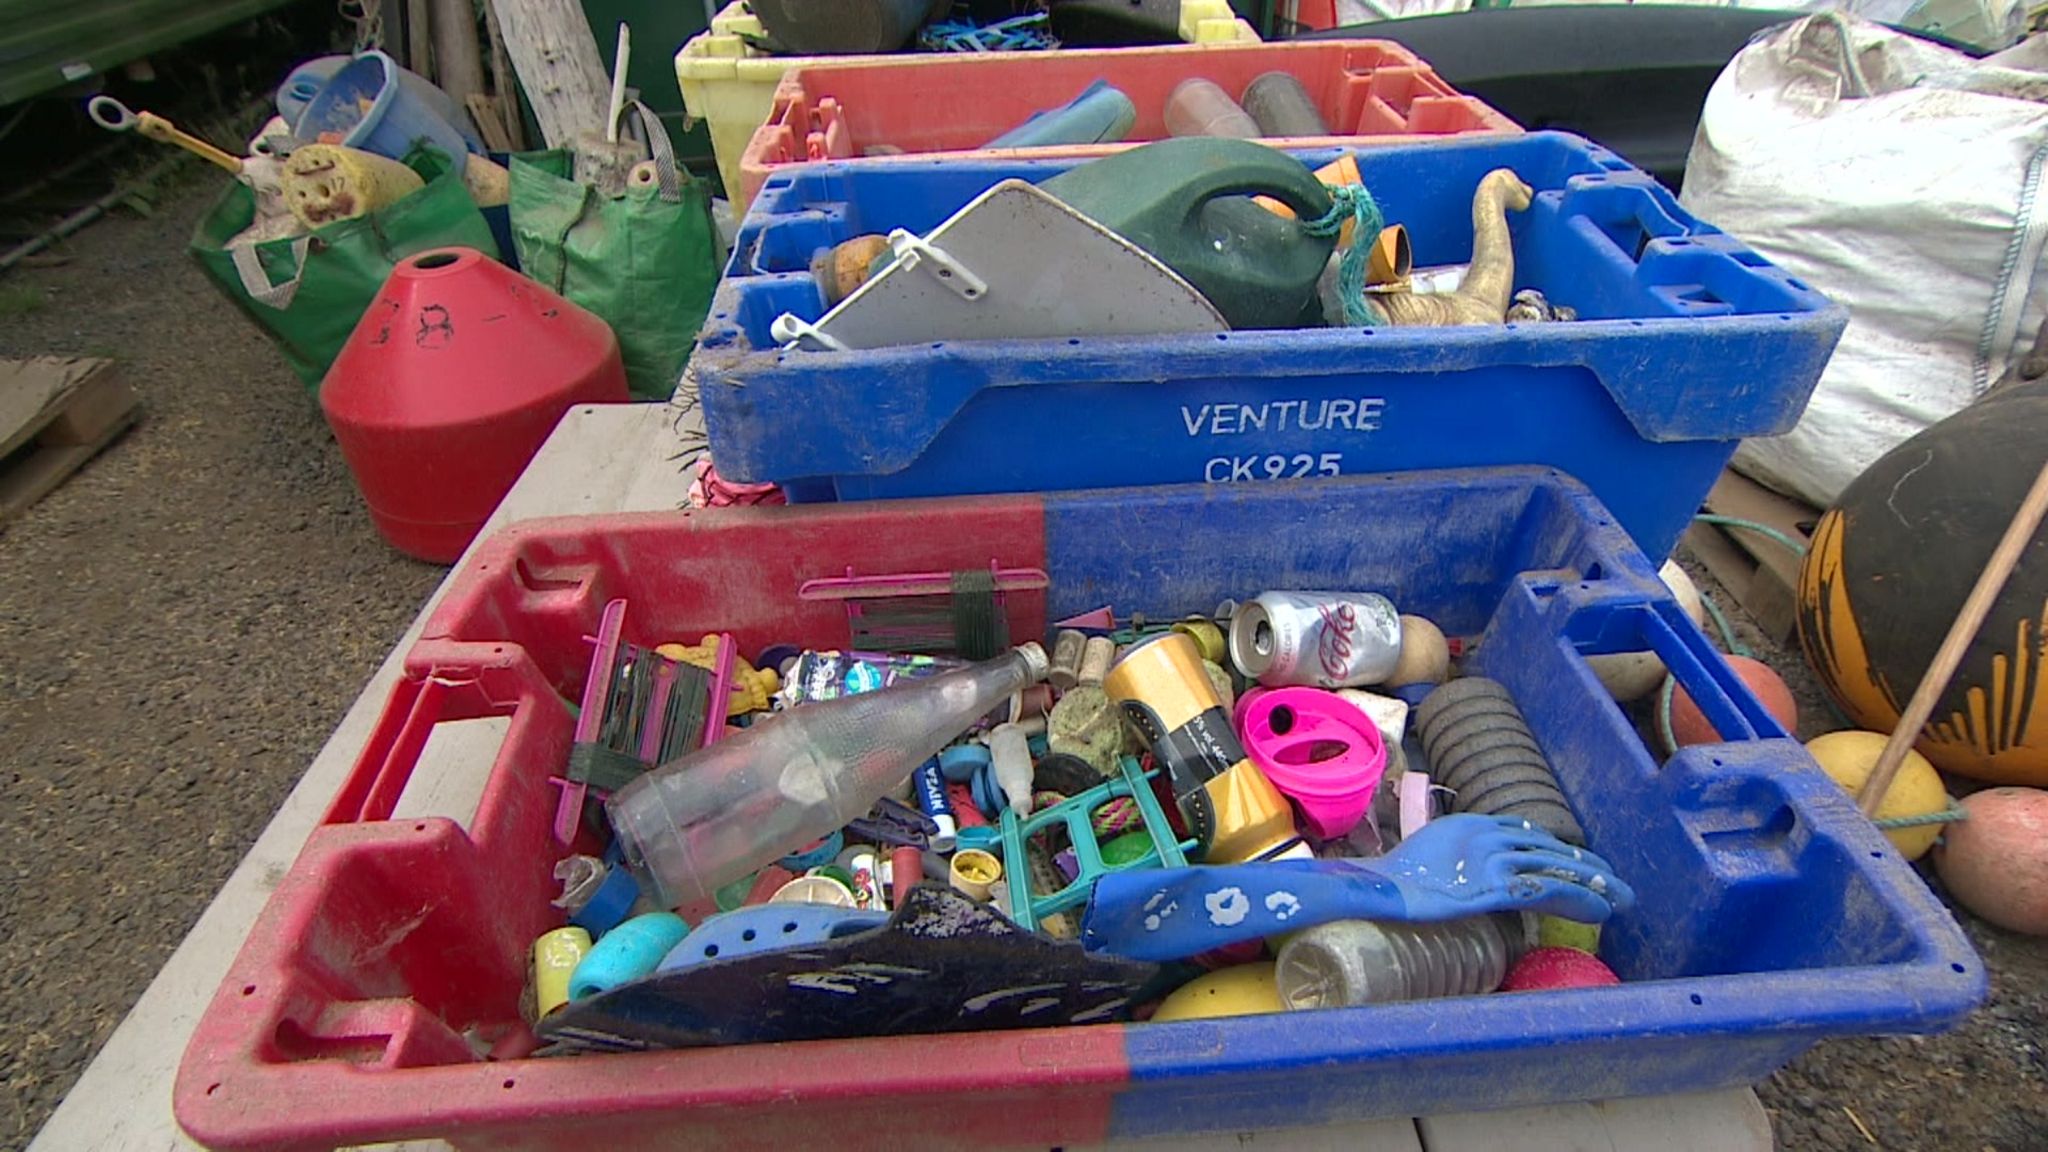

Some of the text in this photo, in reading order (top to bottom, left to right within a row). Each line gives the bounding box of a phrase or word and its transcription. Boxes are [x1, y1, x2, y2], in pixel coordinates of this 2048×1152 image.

[1180, 398, 1386, 437] VENTURE
[1204, 453, 1343, 484] CK925
[1317, 601, 1358, 681] Coke
[925, 766, 945, 812] NIVEA
